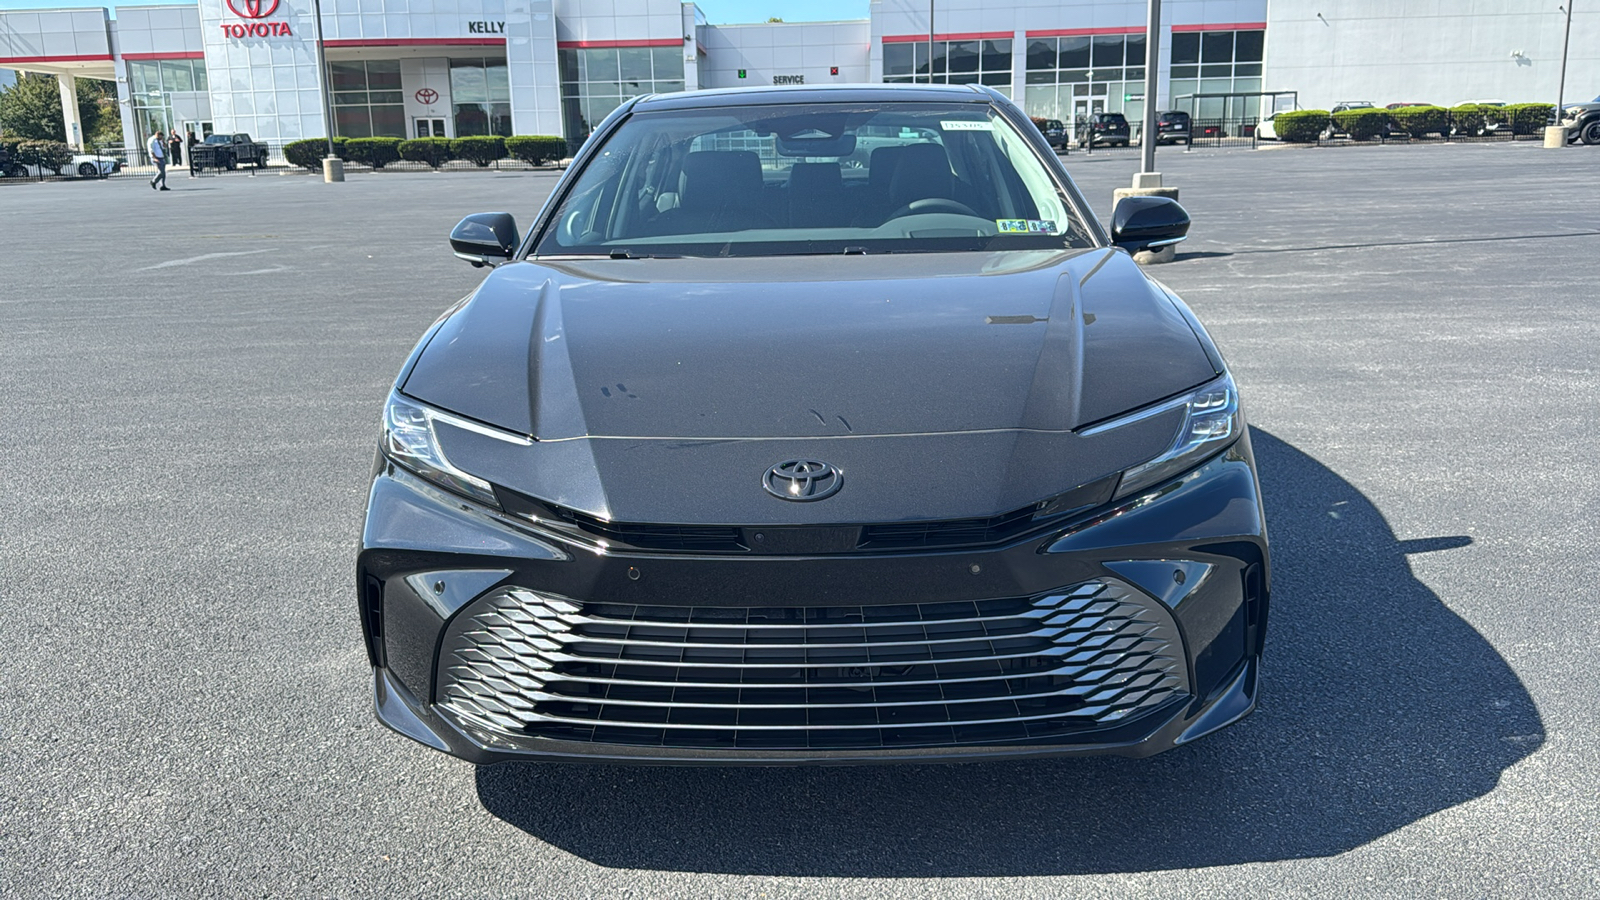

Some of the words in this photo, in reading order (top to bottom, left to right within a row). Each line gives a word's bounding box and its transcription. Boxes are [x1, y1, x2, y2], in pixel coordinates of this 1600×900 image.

[220, 22, 293, 38] TOYOTA
[468, 21, 505, 33] KELLY
[773, 75, 804, 85] SERVICE
